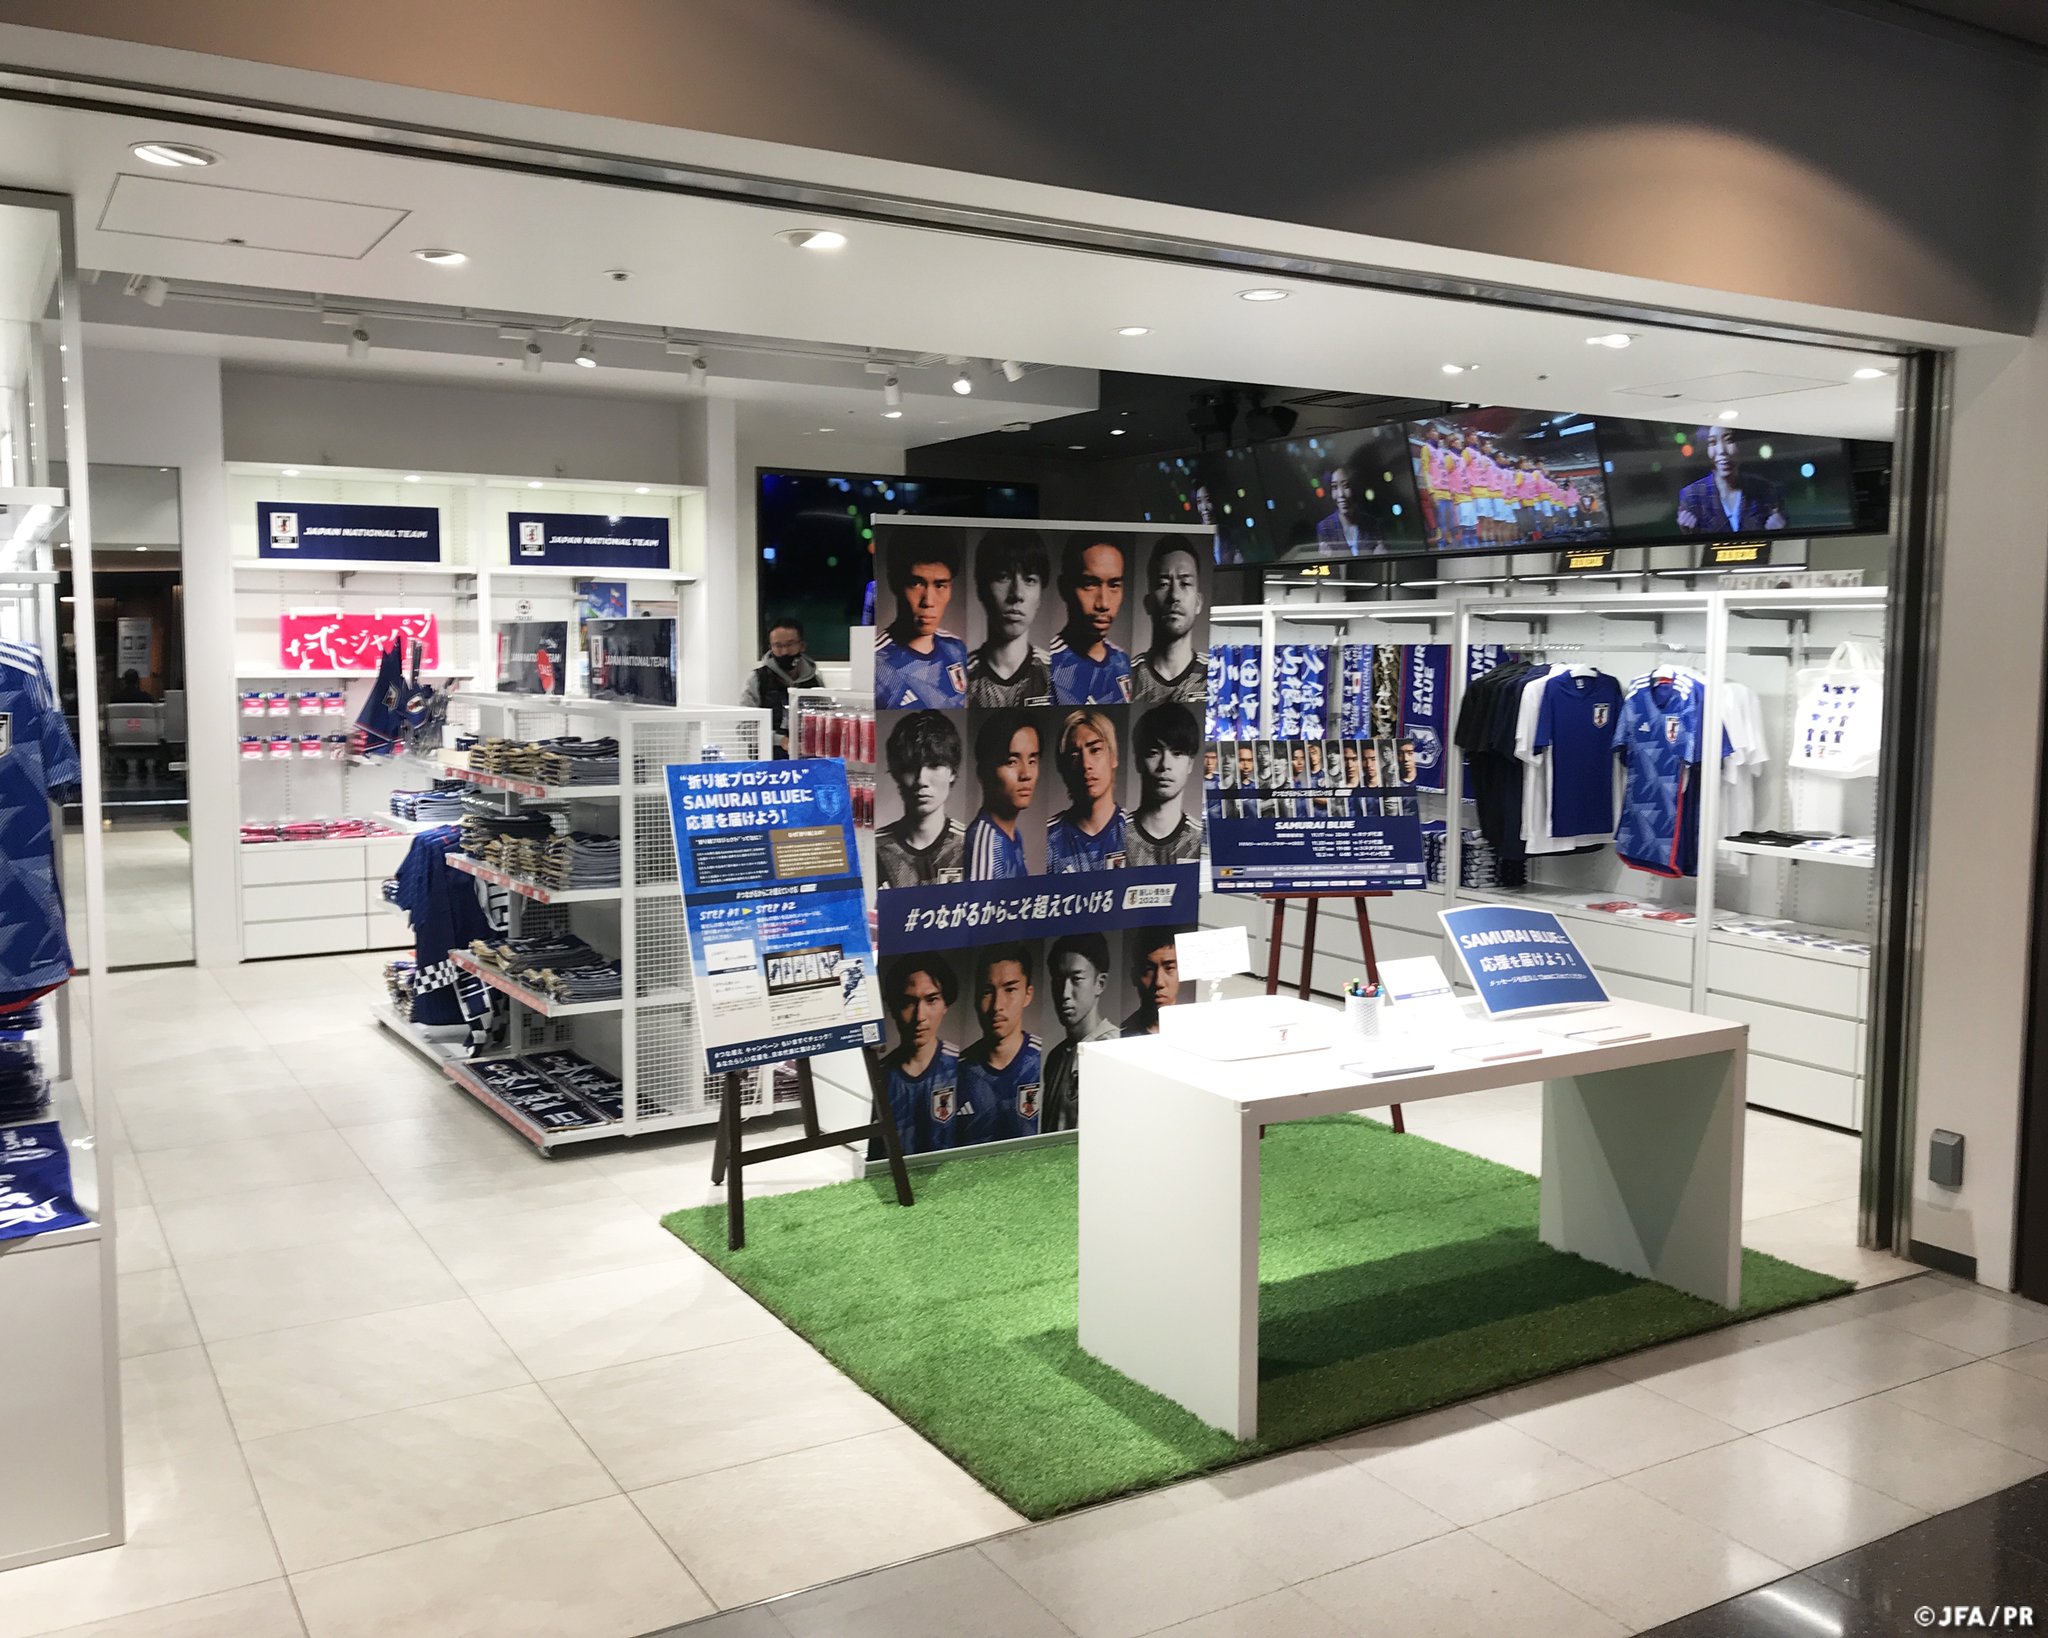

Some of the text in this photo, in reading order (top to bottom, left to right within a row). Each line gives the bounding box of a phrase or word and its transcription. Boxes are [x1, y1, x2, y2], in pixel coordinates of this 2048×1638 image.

[303, 527, 428, 539] JAPAN NATIONAL TEAM
[549, 536, 660, 547] JAPAN NATIONAL TEAM
[1422, 666, 1436, 717] BLUE
[683, 789, 814, 810] SAMURAI BLUEに
[1275, 820, 1356, 830] SAMURAI BLUE
[700, 909, 725, 921] STEP
[755, 904, 780, 915] STEP
[904, 890, 1114, 932] #つながるからこそ超えていける
[1459, 929, 1571, 950] SAMURAI BLUEに
